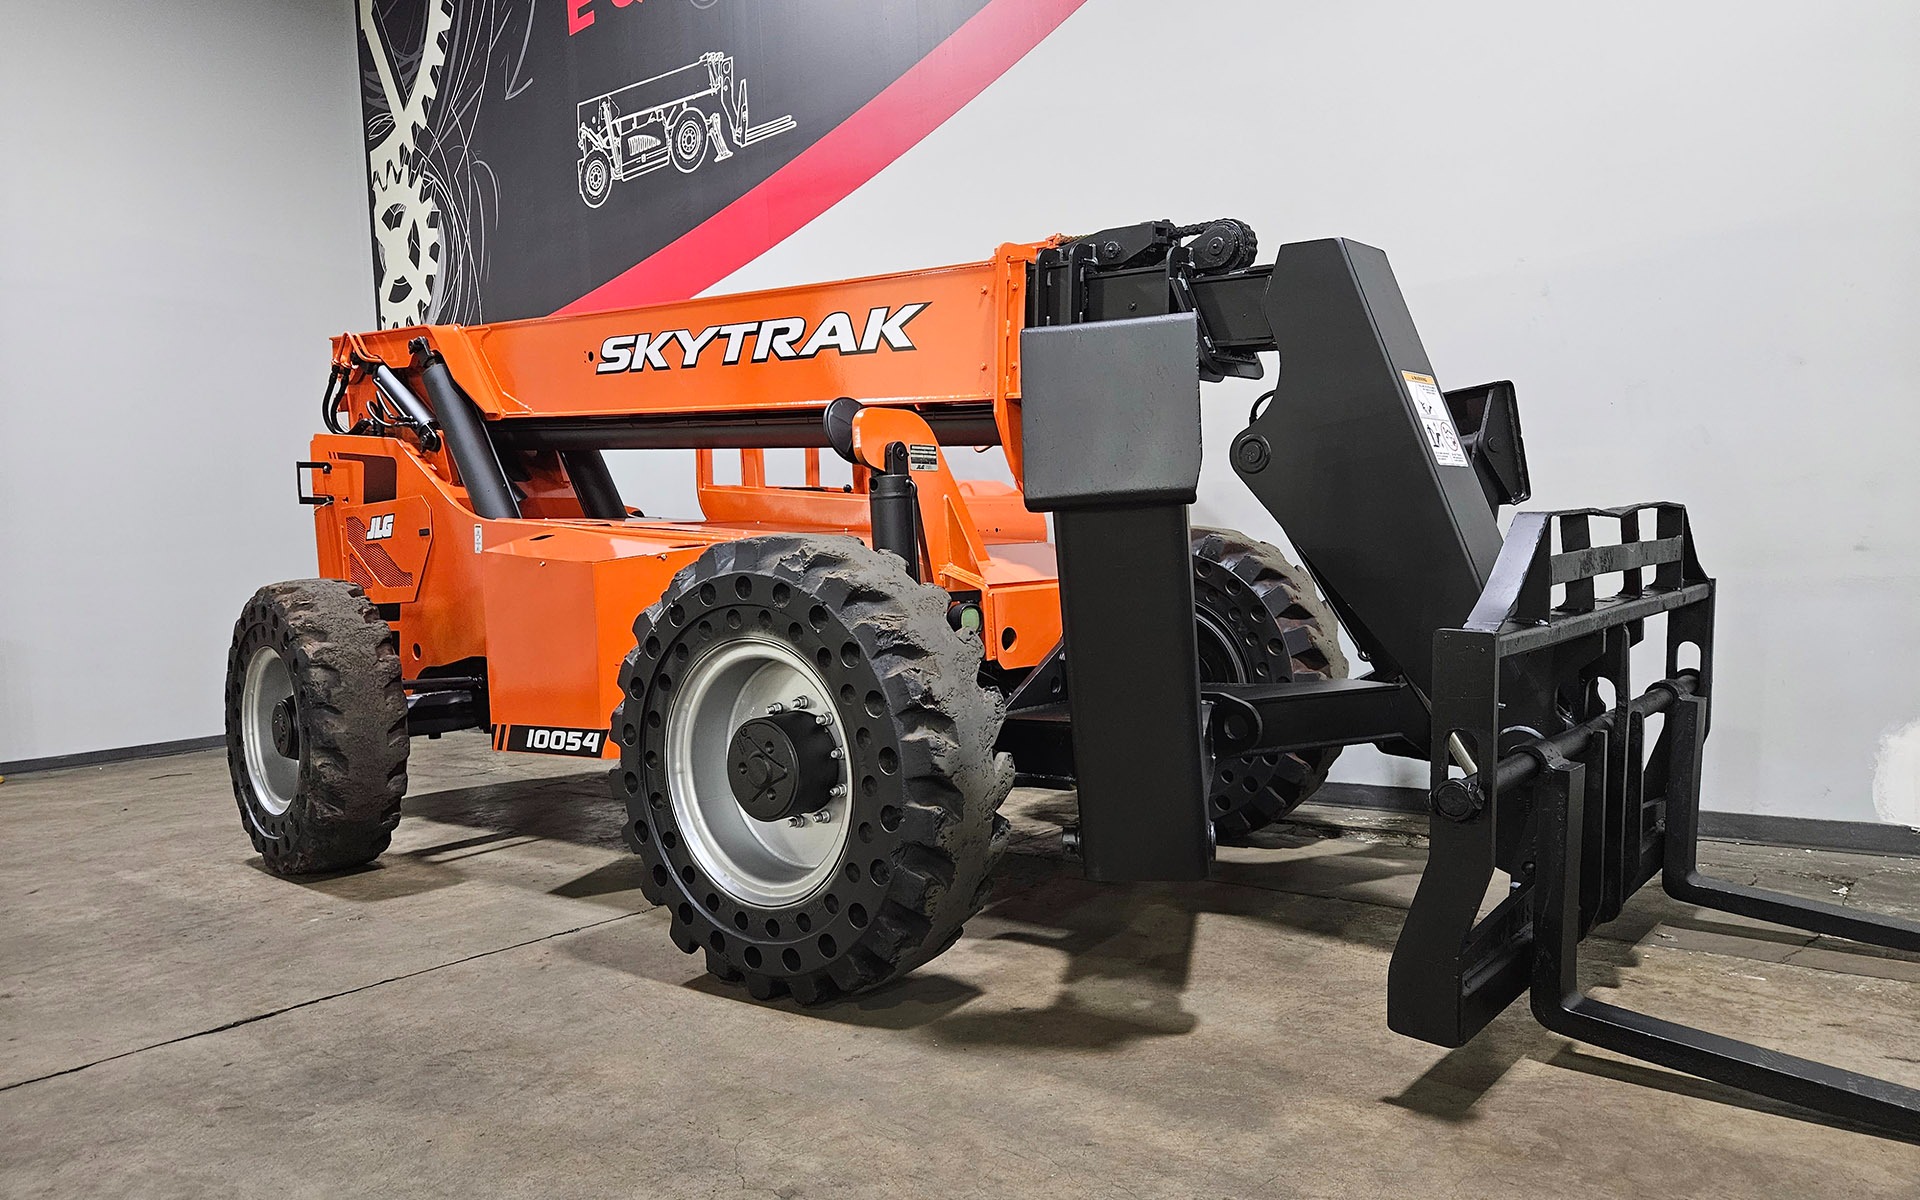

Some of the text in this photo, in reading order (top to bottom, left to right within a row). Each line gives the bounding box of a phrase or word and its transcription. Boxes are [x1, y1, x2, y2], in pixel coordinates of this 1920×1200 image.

[596, 301, 932, 375] SKYTRAK
[366, 513, 395, 541] JLG
[526, 729, 600, 753] 10054
